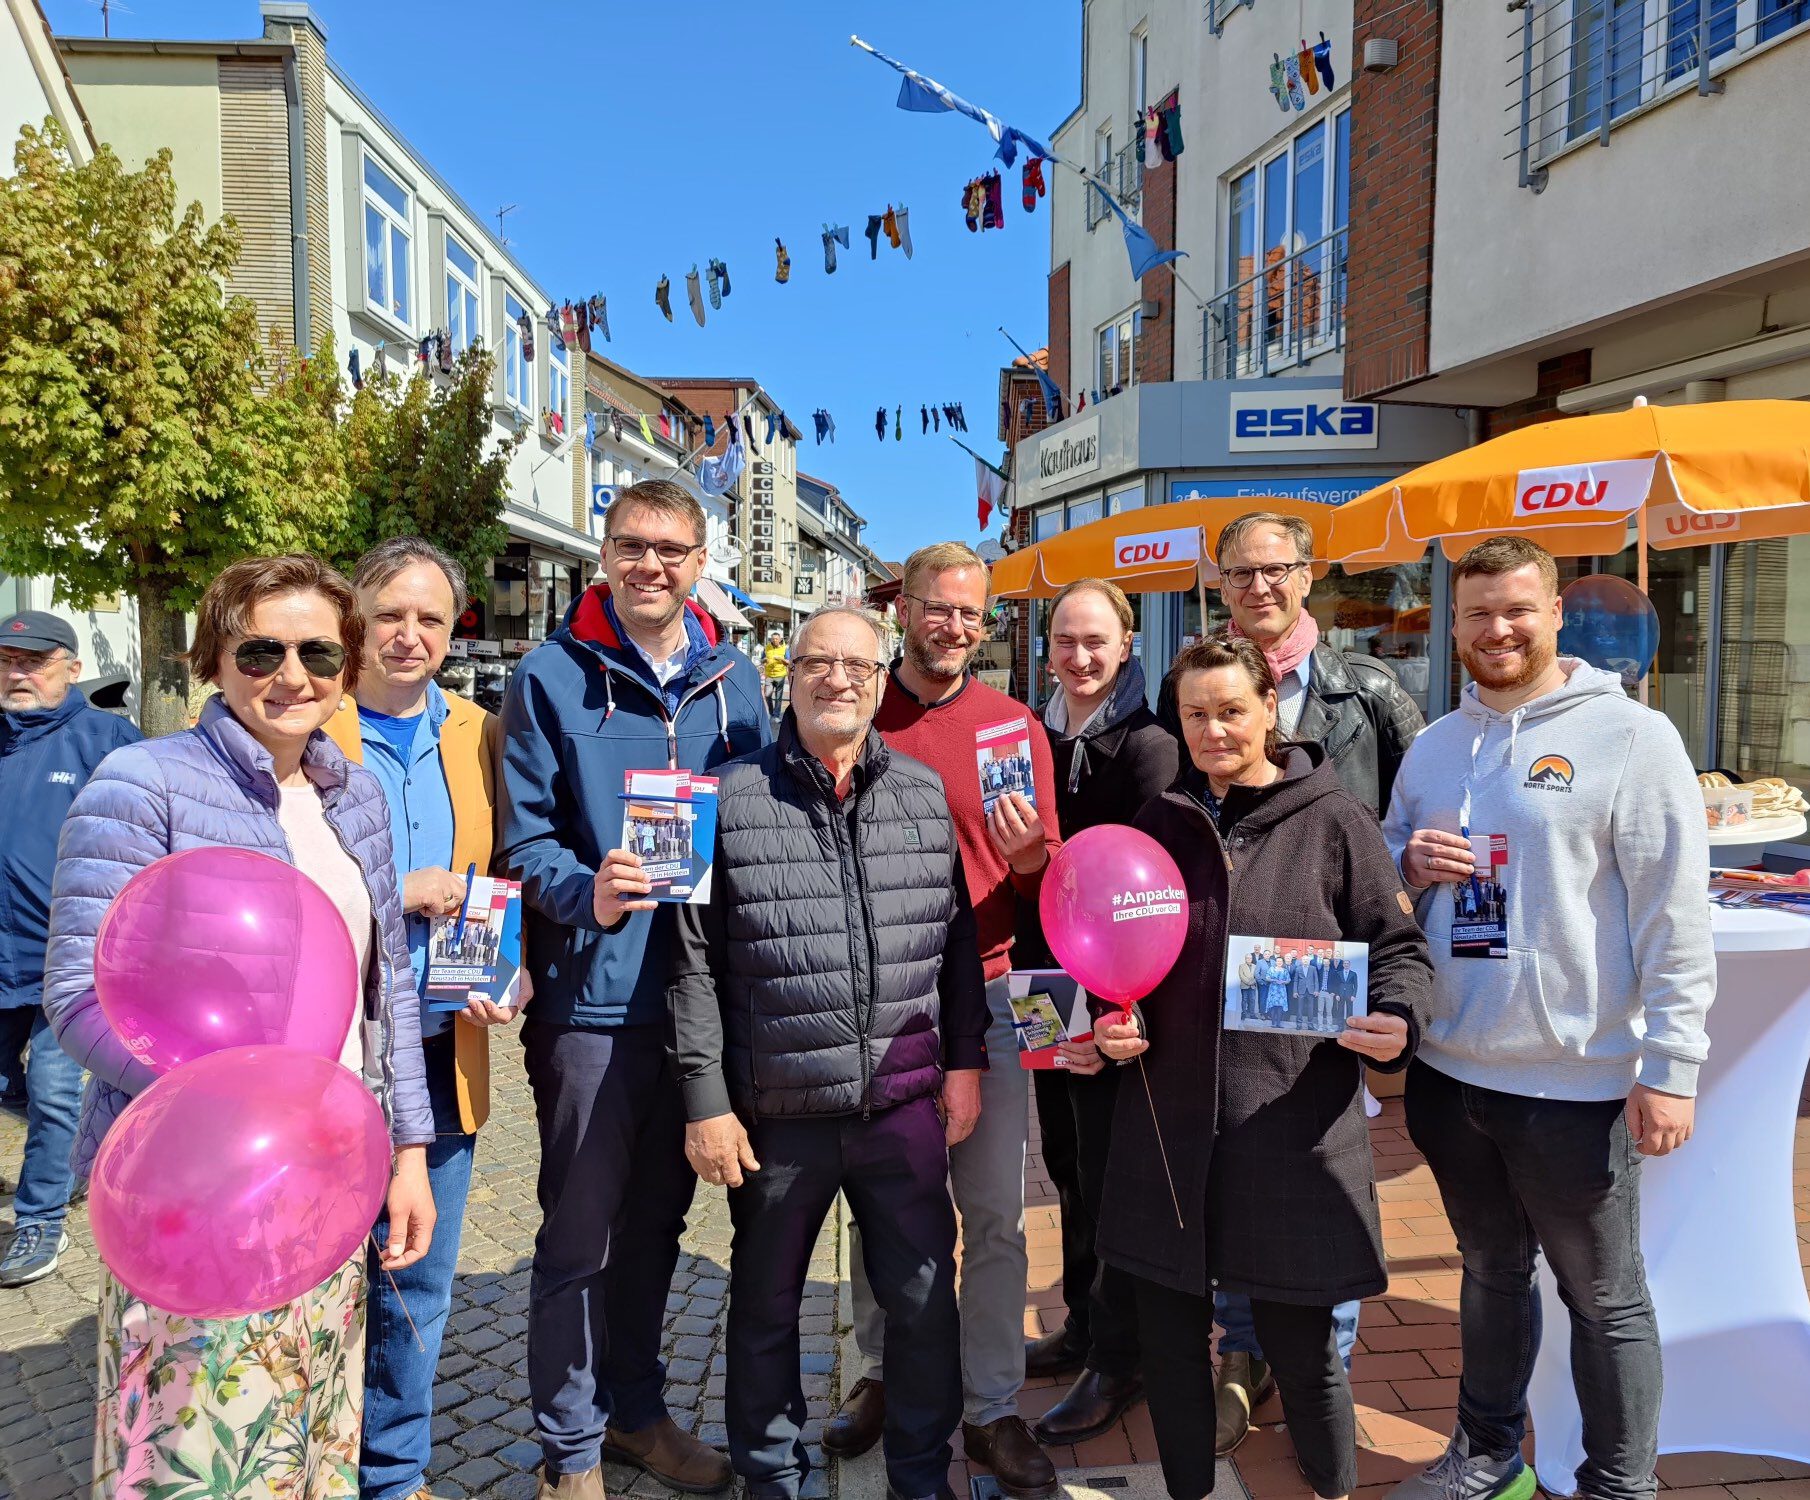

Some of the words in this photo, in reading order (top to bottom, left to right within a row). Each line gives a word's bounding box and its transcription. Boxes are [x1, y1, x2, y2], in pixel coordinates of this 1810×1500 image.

[1235, 404, 1374, 438] eska
[1040, 434, 1096, 479] Kaufhaus
[1521, 480, 1609, 511] CDU
[1118, 541, 1170, 564] CDU
[1523, 781, 1545, 790] NORTH
[1546, 783, 1573, 793] SPORTS
[1112, 884, 1185, 906] #Anpacken
[1115, 911, 1134, 920] Ihre
[1135, 906, 1154, 916] CDU
[1155, 905, 1167, 913] vor
